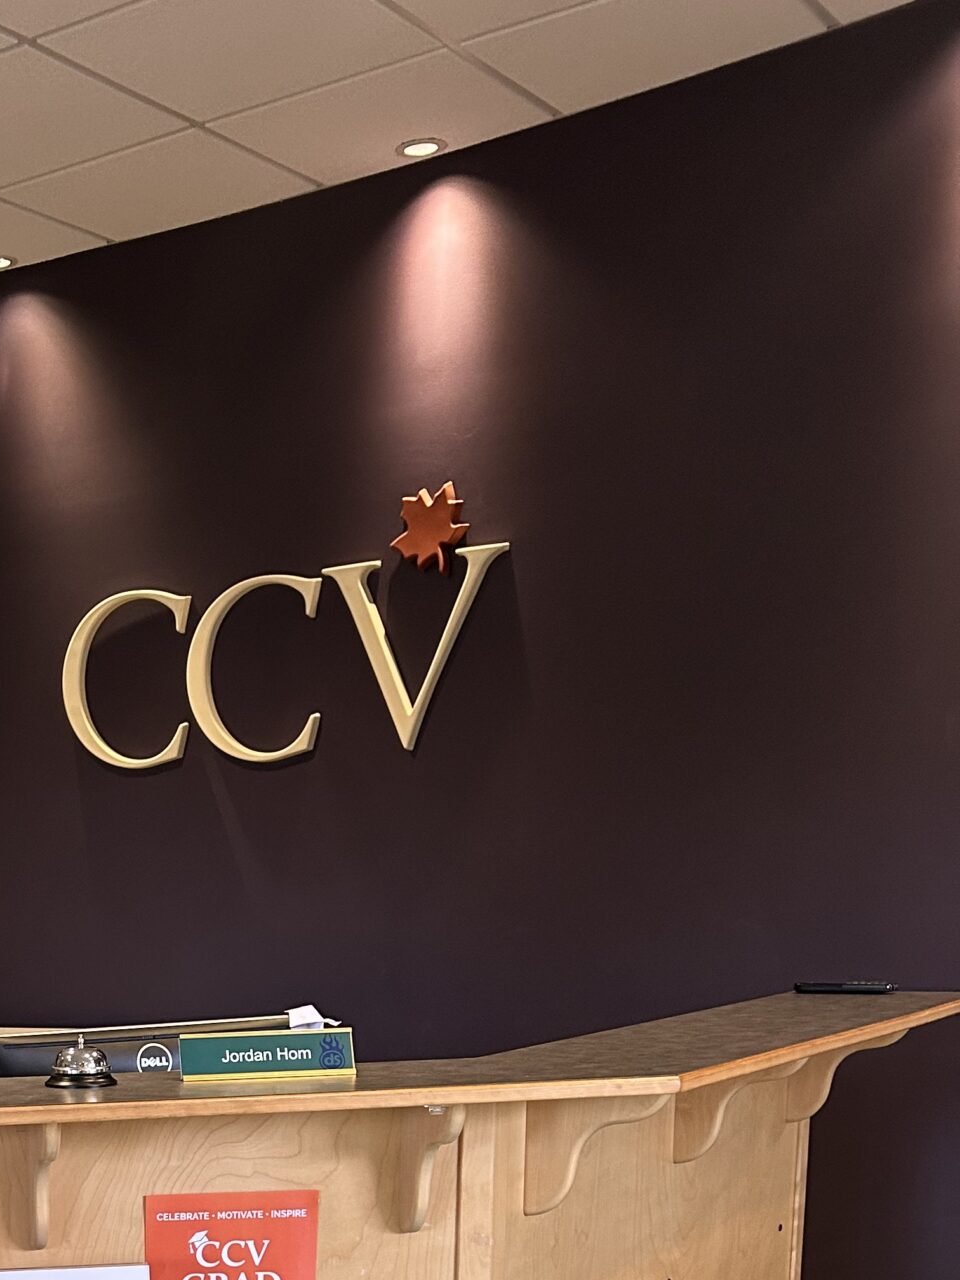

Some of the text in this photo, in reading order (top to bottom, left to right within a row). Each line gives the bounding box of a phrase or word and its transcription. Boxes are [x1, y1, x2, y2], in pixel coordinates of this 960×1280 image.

[61, 542, 510, 770] CCV
[141, 1056, 169, 1067] DELL
[221, 1047, 312, 1063] Jordan Hom
[156, 1209, 307, 1222] CELEBRATE MOTIVATE INSPIRE
[195, 1240, 270, 1268] CCV
